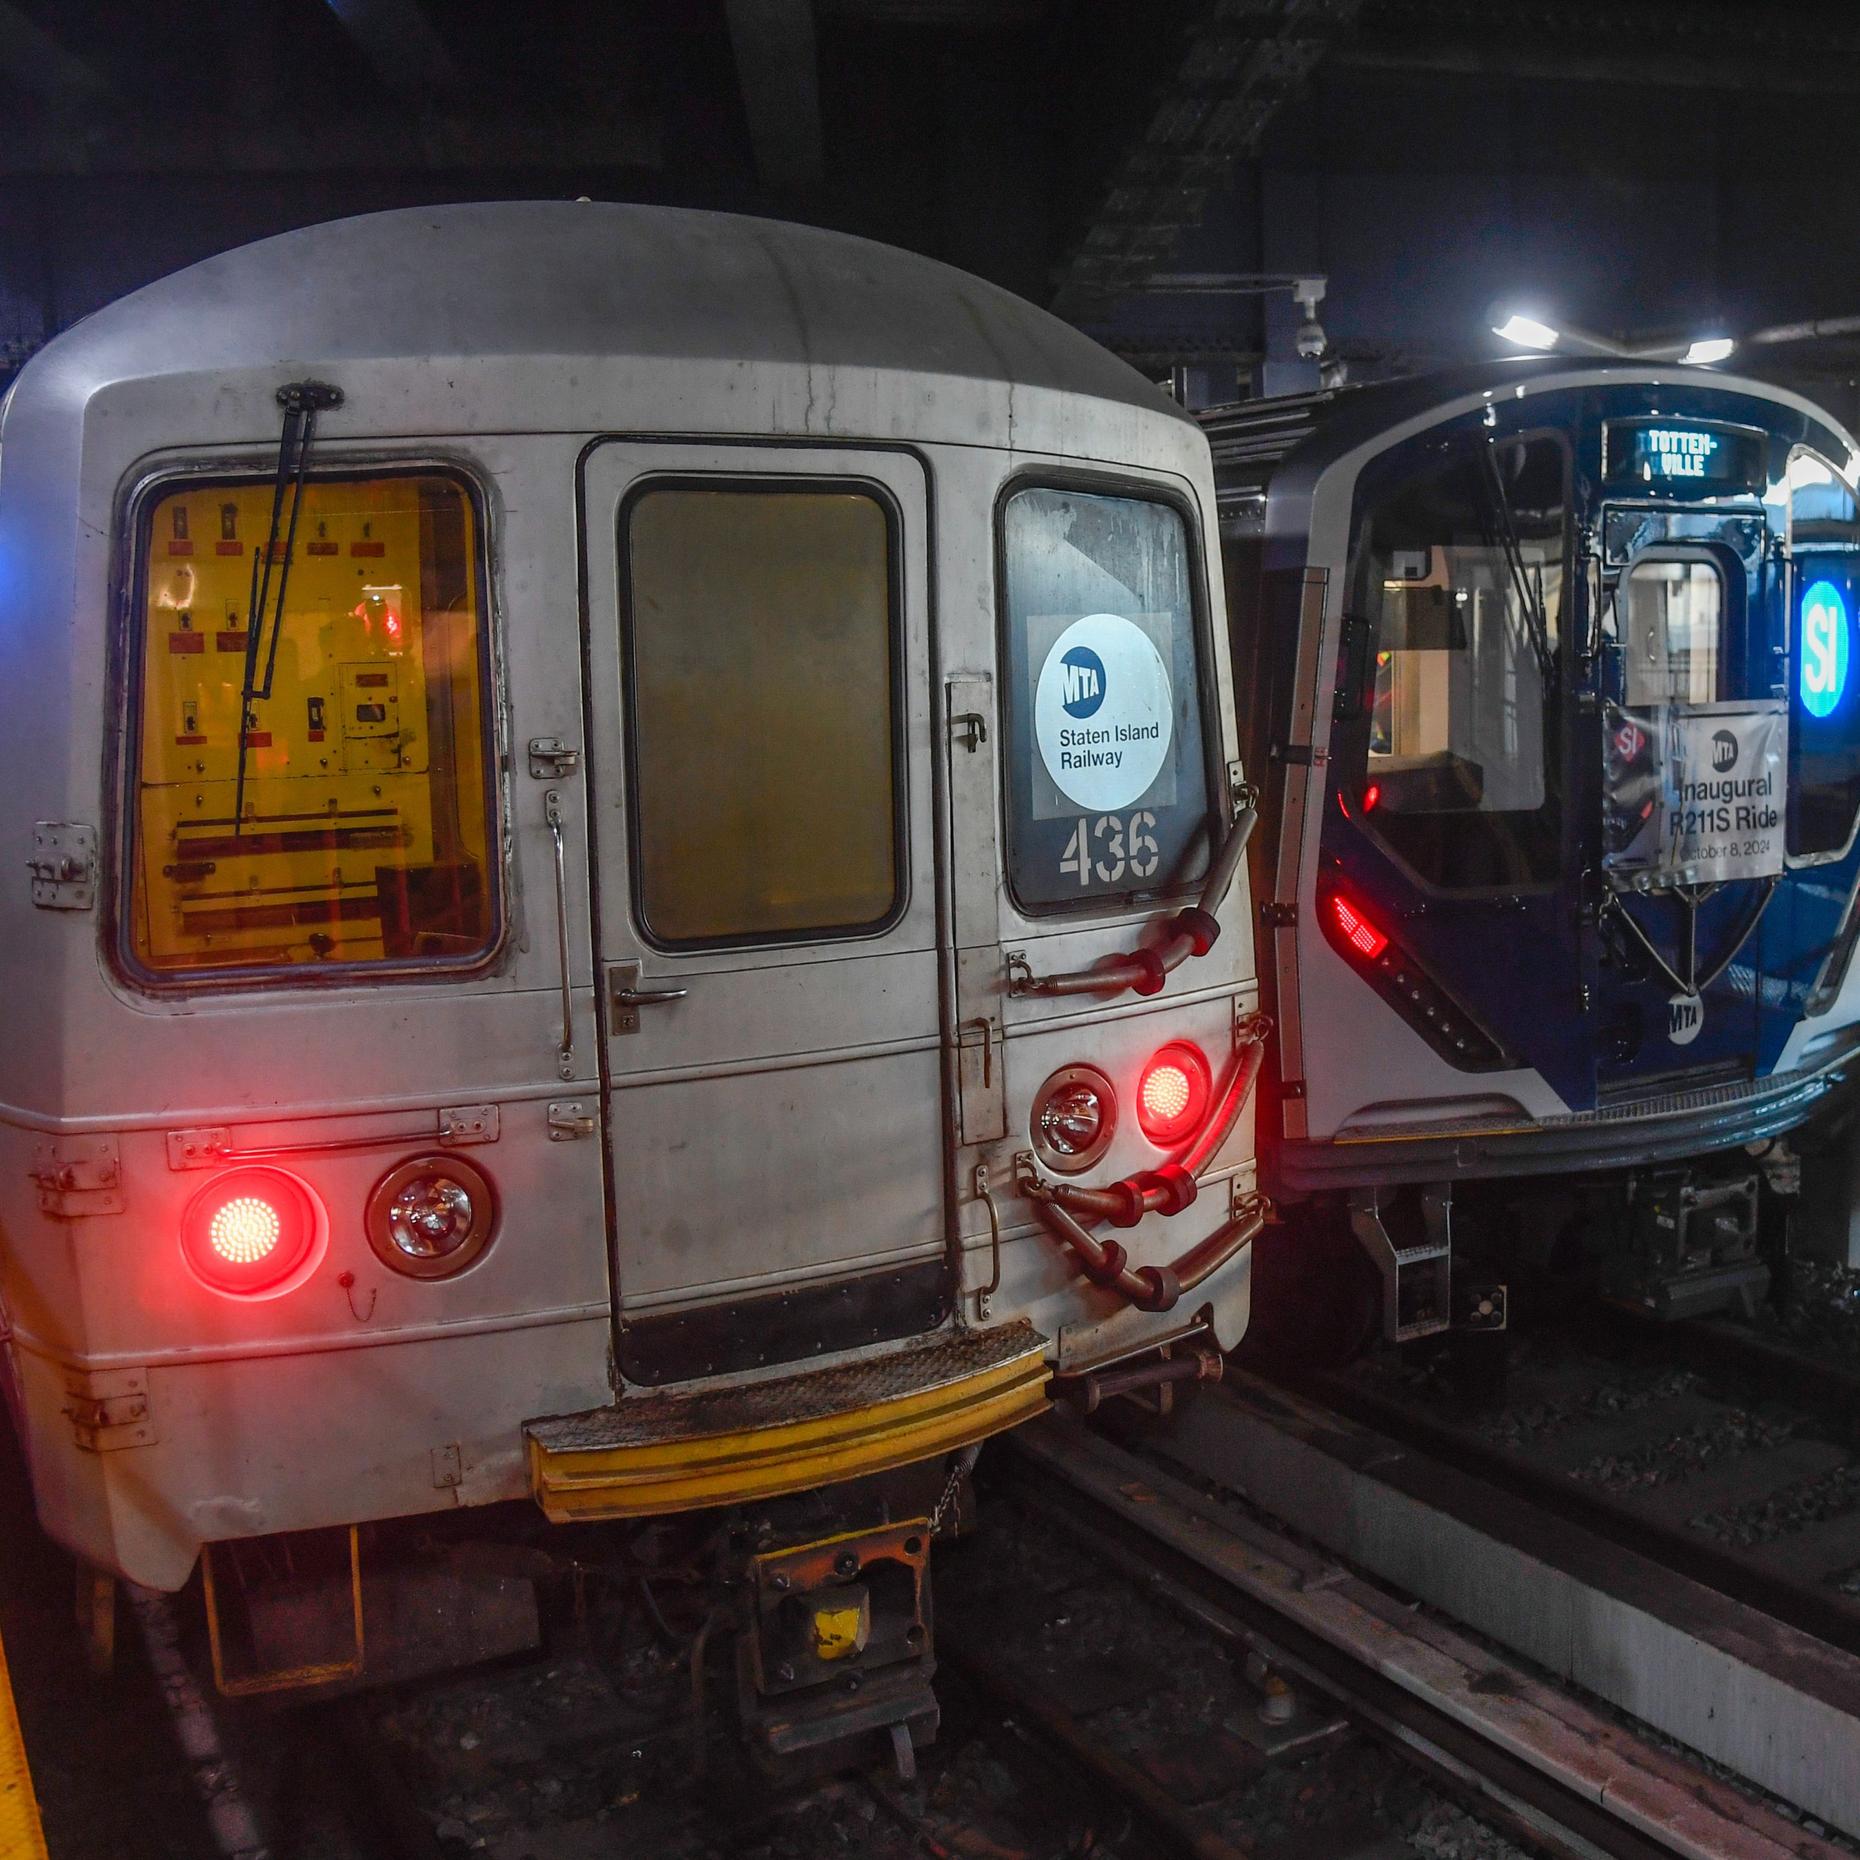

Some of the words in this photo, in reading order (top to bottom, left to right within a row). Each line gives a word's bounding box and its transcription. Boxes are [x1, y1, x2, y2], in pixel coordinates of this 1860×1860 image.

[1649, 429, 1717, 455] TOTTEN-
[1661, 453, 1705, 477] VILLE
[1805, 603, 1838, 693] SI
[1061, 664, 1100, 705] MTA
[1060, 728, 1110, 748] Staten
[1115, 721, 1159, 743] Island
[1618, 726, 1638, 755] SI
[1060, 750, 1123, 770] Railway
[1712, 739, 1735, 765] MTA
[1670, 807, 1730, 836] R211S
[1735, 804, 1777, 831] Ride
[1059, 811, 1159, 887] 436
[1730, 842, 1742, 858] 8,
[1667, 1003, 1697, 1034] MTA
